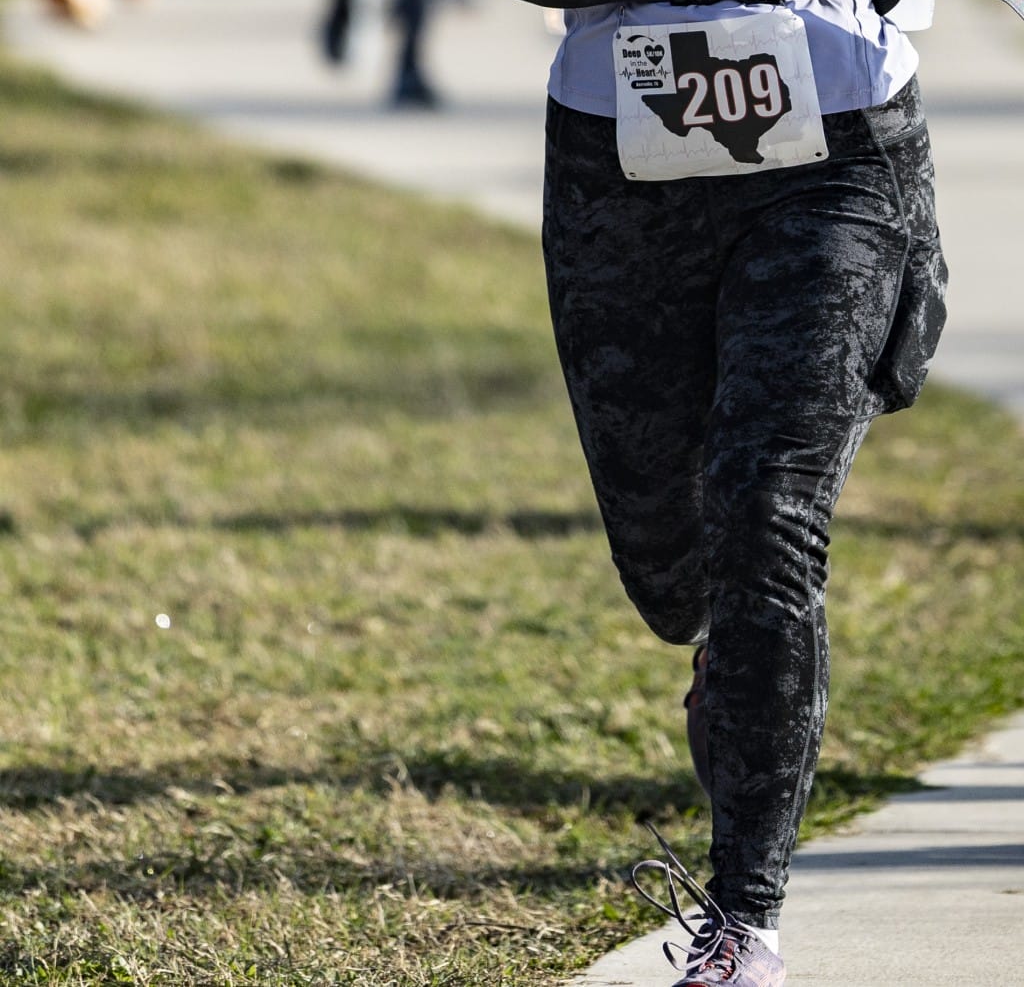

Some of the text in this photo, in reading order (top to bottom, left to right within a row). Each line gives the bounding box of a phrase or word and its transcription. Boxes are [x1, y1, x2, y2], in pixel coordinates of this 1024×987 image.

[622, 49, 641, 58] Deep
[636, 68, 656, 77] Heart
[677, 63, 782, 126] 209
